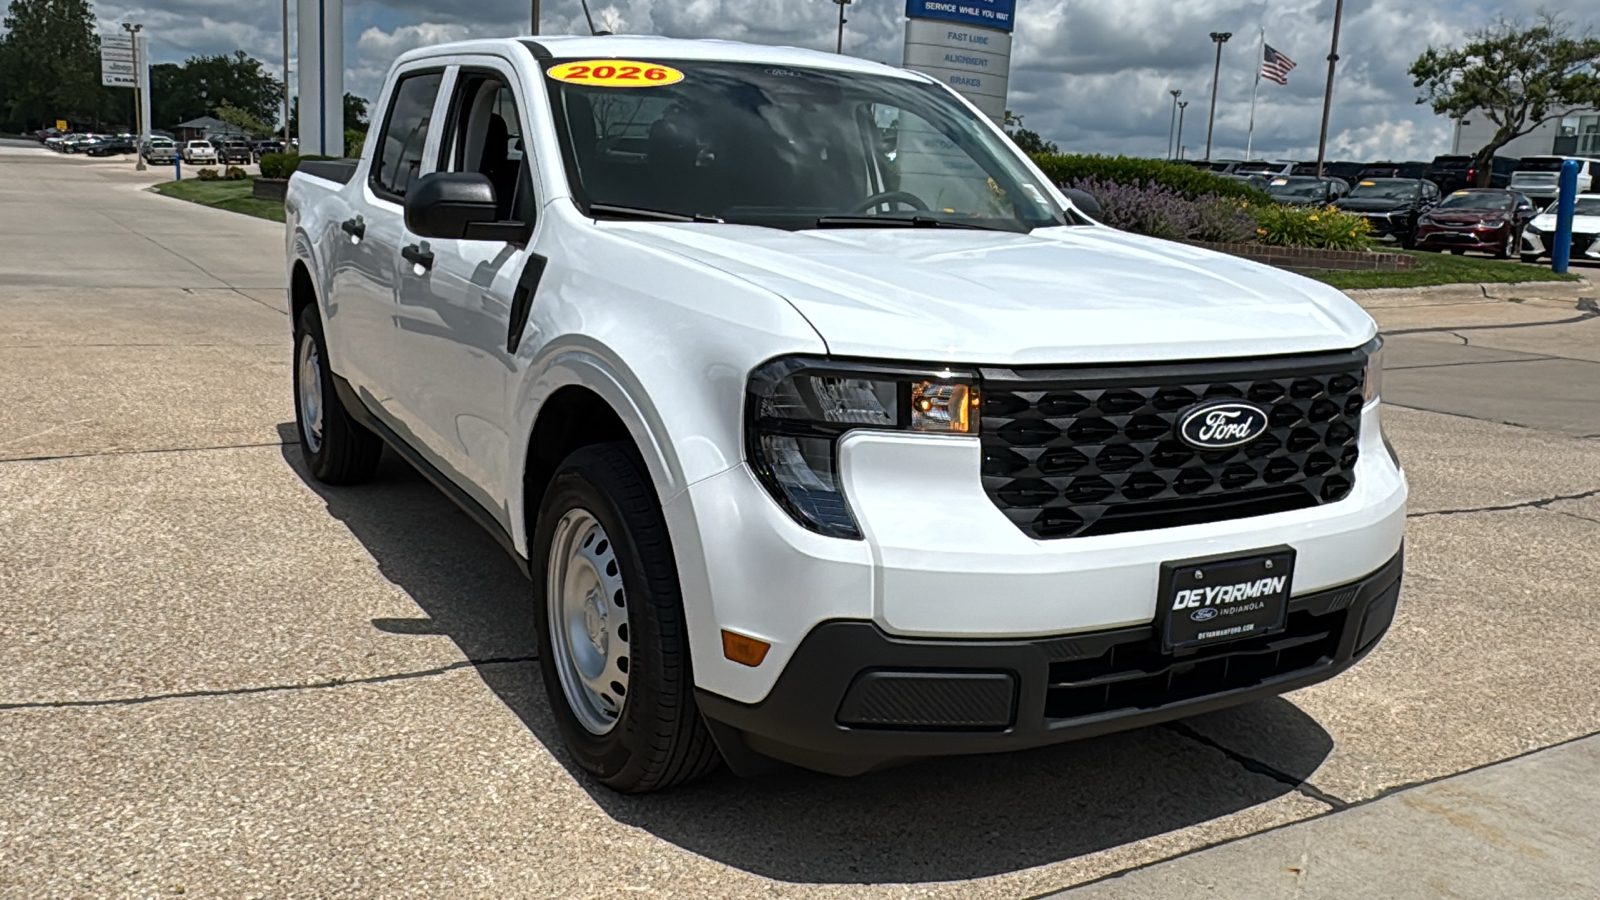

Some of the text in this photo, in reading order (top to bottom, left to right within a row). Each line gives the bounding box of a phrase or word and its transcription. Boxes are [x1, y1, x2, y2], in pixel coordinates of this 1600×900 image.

[925, 2, 1009, 21] SERVICE WHILE YOU WAIT
[947, 31, 989, 45] FAST LUBE
[944, 54, 988, 66] ALIGNMENT
[564, 65, 668, 81] 2026
[950, 75, 981, 88] BRAKES
[1199, 411, 1253, 441] Ford
[1172, 575, 1287, 611] DEYARMAN
[1220, 601, 1264, 616] INDIANOLA
